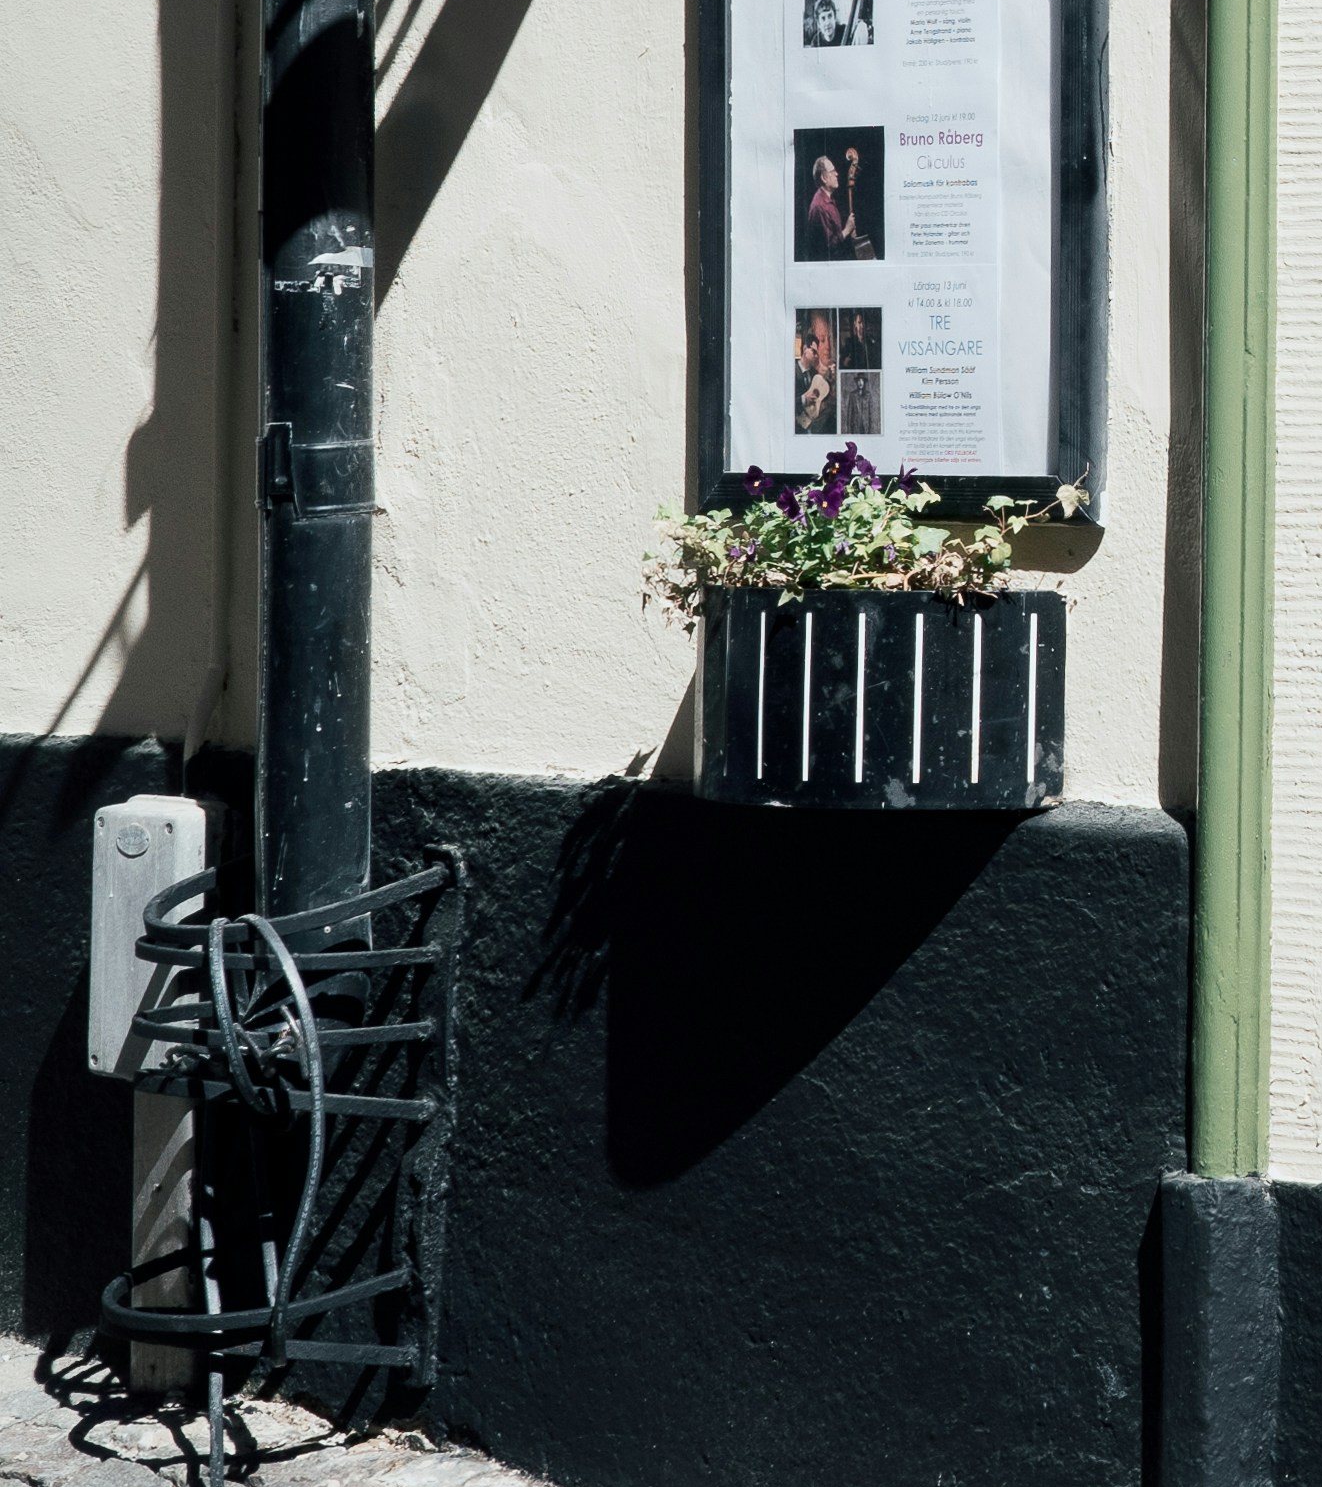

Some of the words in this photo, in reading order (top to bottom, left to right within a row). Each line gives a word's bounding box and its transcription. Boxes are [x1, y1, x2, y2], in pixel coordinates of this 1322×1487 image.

[899, 132, 934, 146] Bruno
[938, 128, 984, 148] Råberg
[913, 281, 941, 293] Lördag
[943, 280, 952, 291] 13
[952, 280, 967, 293] juni
[928, 315, 951, 330] TRE
[897, 335, 984, 356] VISSÅNGARE
